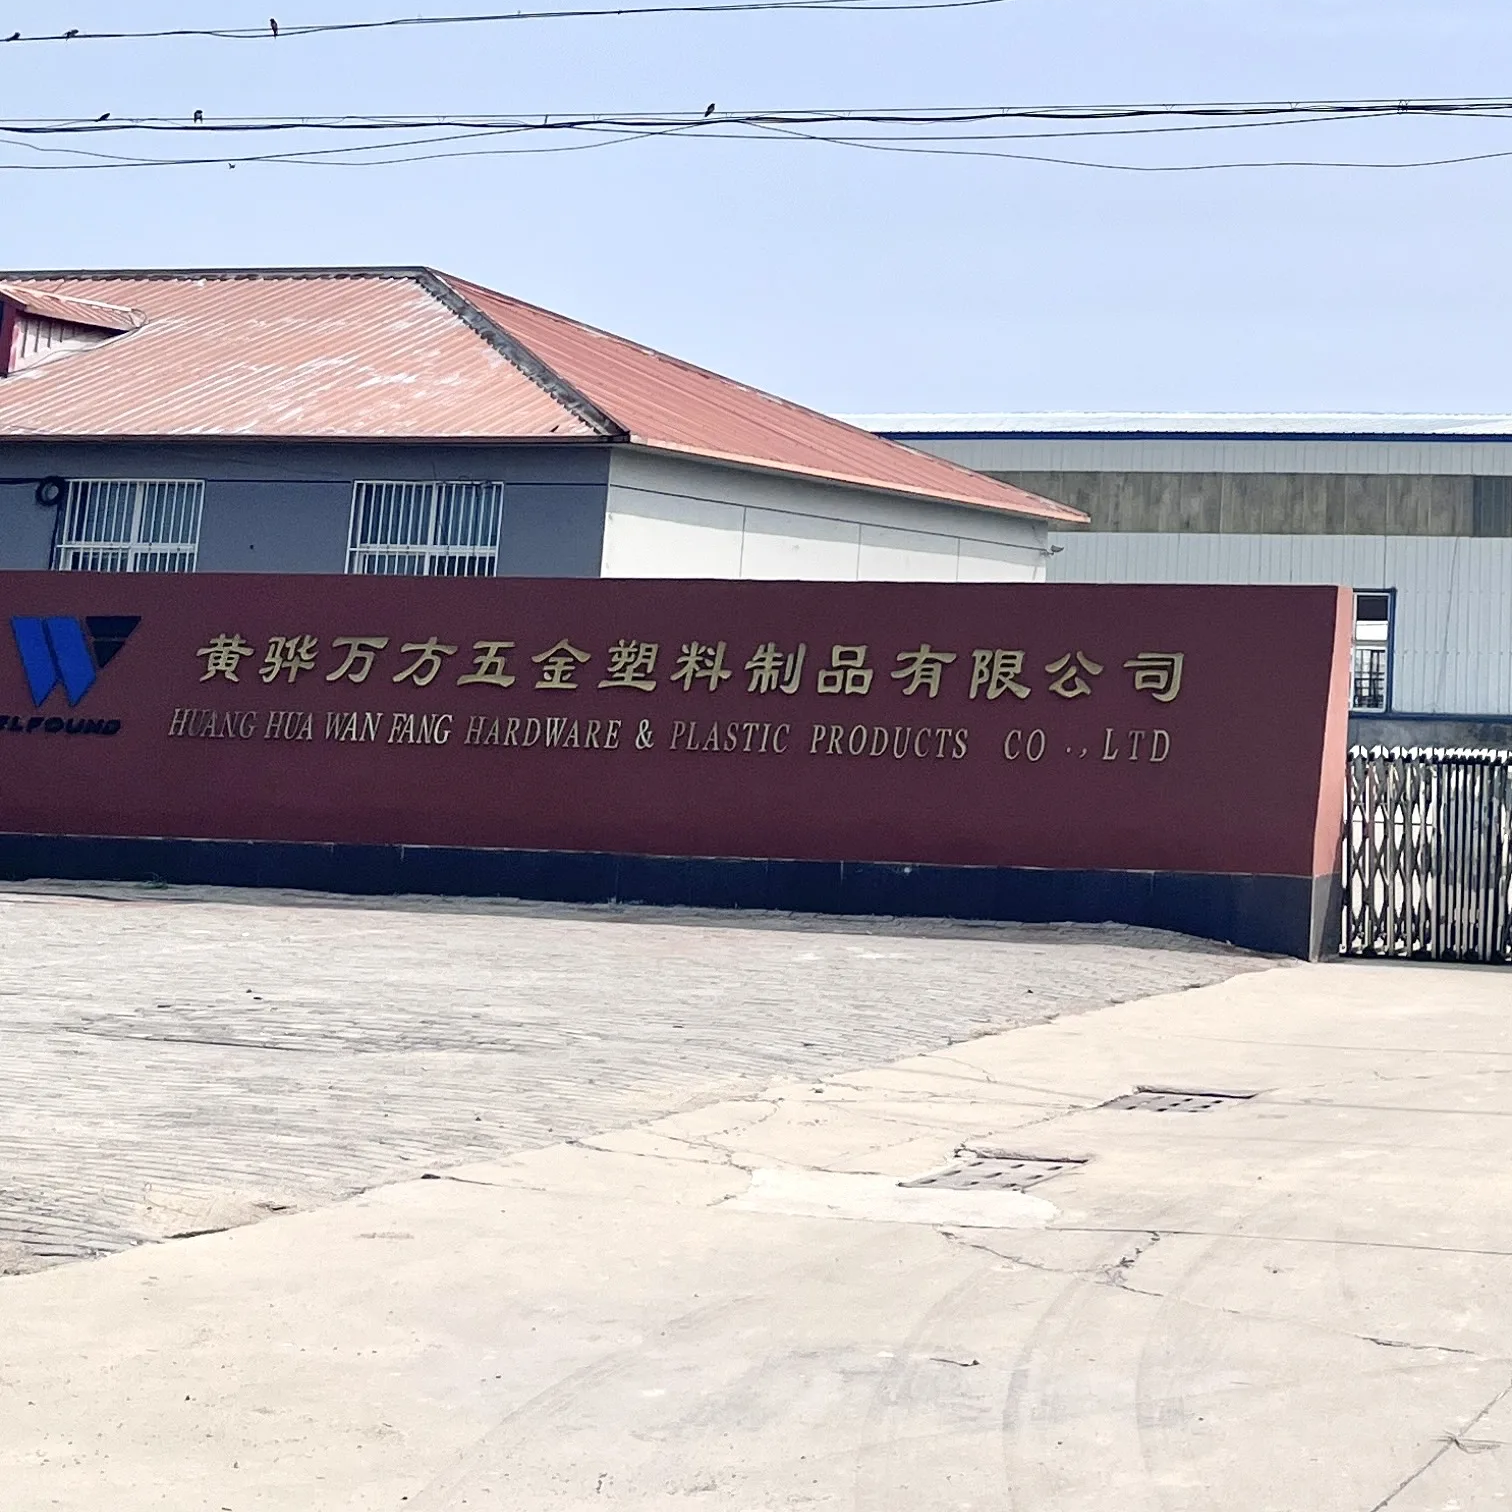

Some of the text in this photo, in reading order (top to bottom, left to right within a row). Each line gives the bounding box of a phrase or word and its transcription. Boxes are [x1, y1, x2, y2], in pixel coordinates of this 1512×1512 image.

[196, 633, 1186, 702] 黄骅万方五金塑料制品有限公司
[167, 707, 259, 739] HUANG
[263, 710, 314, 741] HUA
[324, 711, 384, 742] WAN
[387, 712, 454, 745] FANG
[463, 715, 622, 749] HARDWARE
[634, 718, 656, 750] &
[669, 720, 791, 753] PLASTIC
[809, 724, 969, 759] PRODUCTS
